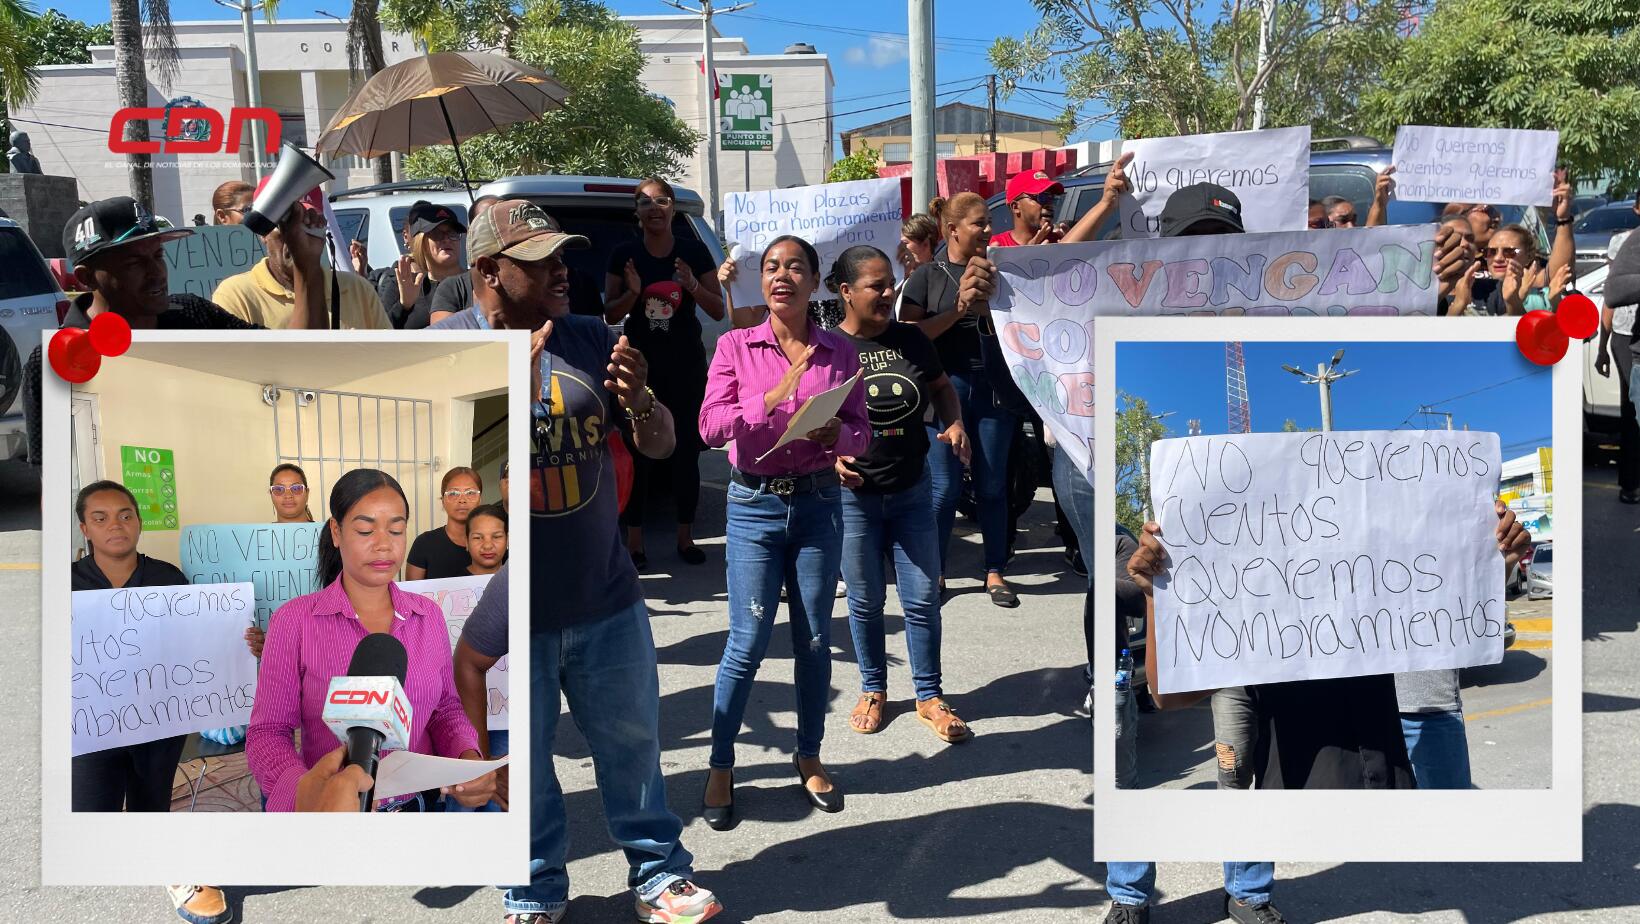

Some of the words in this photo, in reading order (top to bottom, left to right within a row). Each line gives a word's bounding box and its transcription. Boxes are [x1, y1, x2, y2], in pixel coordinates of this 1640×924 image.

[1400, 132, 1420, 152] No
[1435, 138, 1506, 159] queremos
[1129, 161, 1158, 193] No
[1166, 163, 1279, 190] queremos
[1470, 162, 1537, 180] queremos
[734, 193, 756, 215] No
[769, 191, 799, 218] hay
[814, 189, 870, 213] plazas
[1398, 179, 1502, 199] nombramientos
[997, 258, 1098, 307] NO
[1106, 240, 1436, 308] VENGAN
[1003, 318, 1094, 365] CO
[1013, 364, 1094, 416] ME
[135, 449, 160, 463] NO
[1168, 438, 1252, 493] NO
[188, 529, 220, 564] NO
[251, 568, 314, 601] CUENT
[111, 589, 246, 624] queremos
[329, 690, 389, 705] CDN
